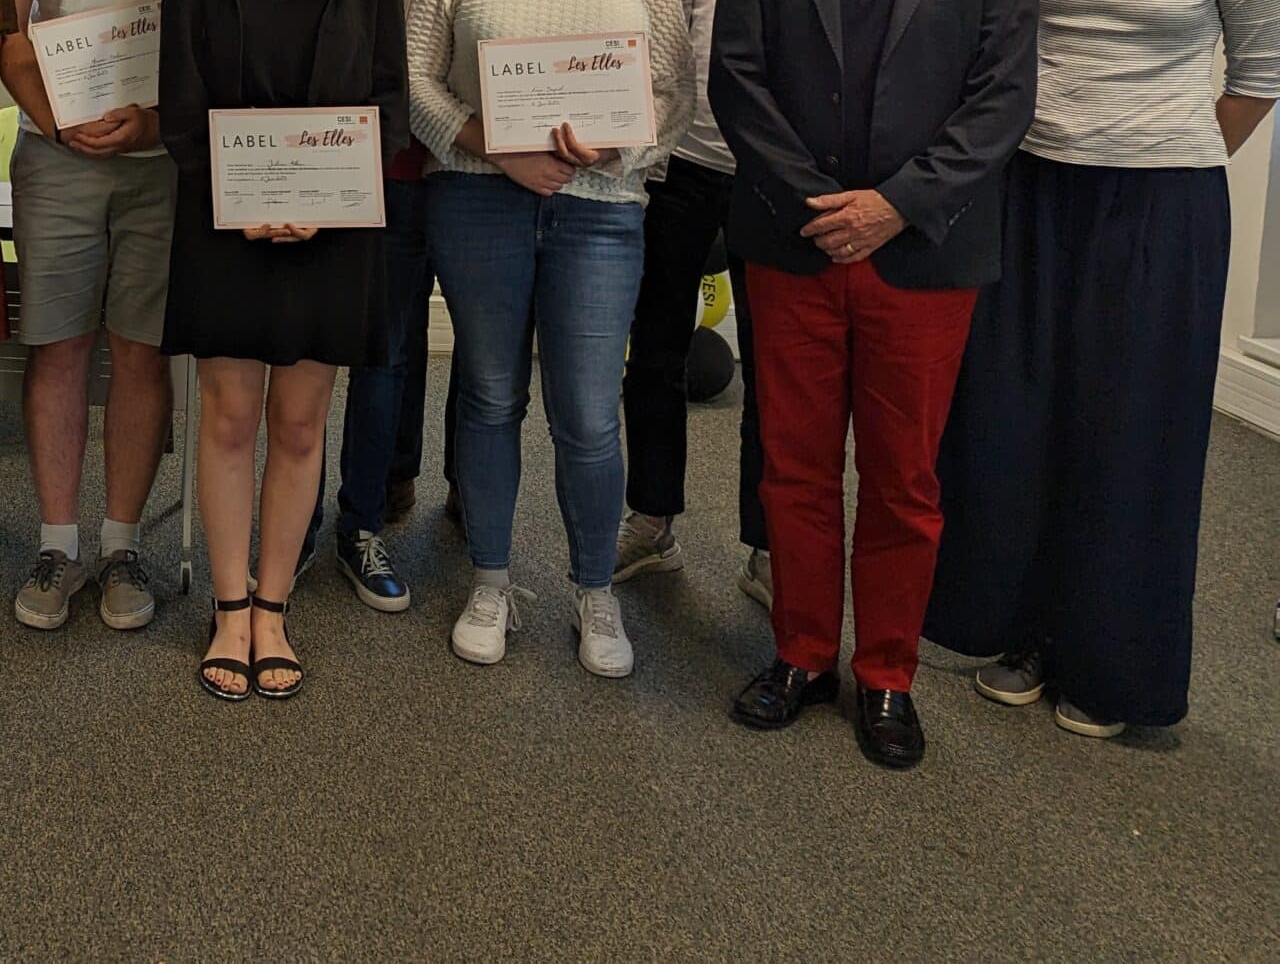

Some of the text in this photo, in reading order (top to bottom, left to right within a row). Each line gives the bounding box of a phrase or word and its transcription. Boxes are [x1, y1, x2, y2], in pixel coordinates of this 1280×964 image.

[45, 17, 157, 57] LABEL Les Elles
[491, 53, 624, 77] LABEL Les Elles
[222, 128, 356, 148] LABEL Les Elles
